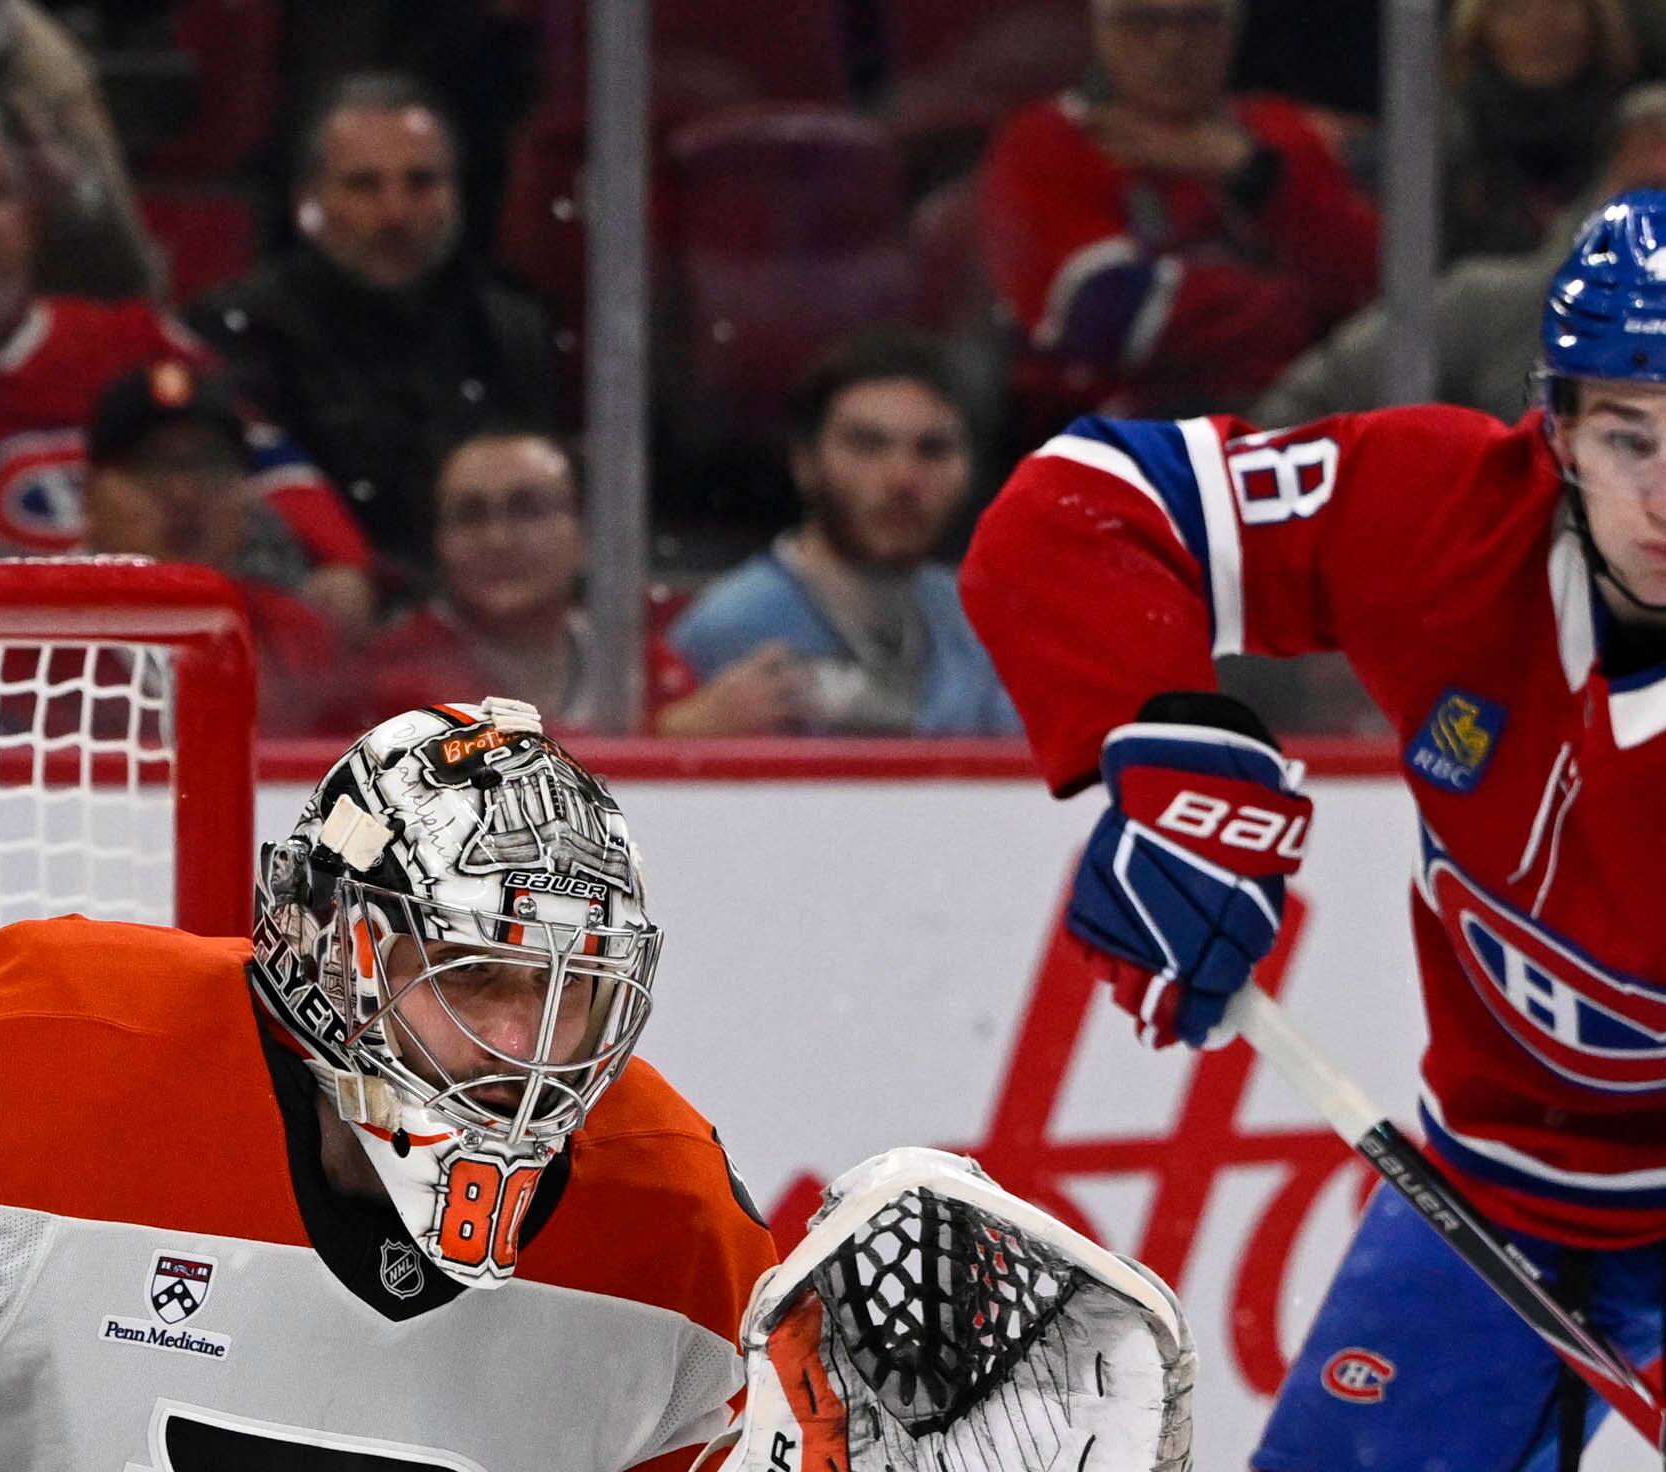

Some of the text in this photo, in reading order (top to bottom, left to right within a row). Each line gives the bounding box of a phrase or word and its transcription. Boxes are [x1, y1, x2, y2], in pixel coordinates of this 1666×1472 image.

[1413, 746, 1471, 790] RBC
[504, 870, 608, 900] BAUER
[1358, 1137, 1460, 1232] BAUER
[435, 1155, 544, 1271] 80
[388, 1257, 413, 1285] NHL
[104, 1320, 226, 1358] Penn Medicine
